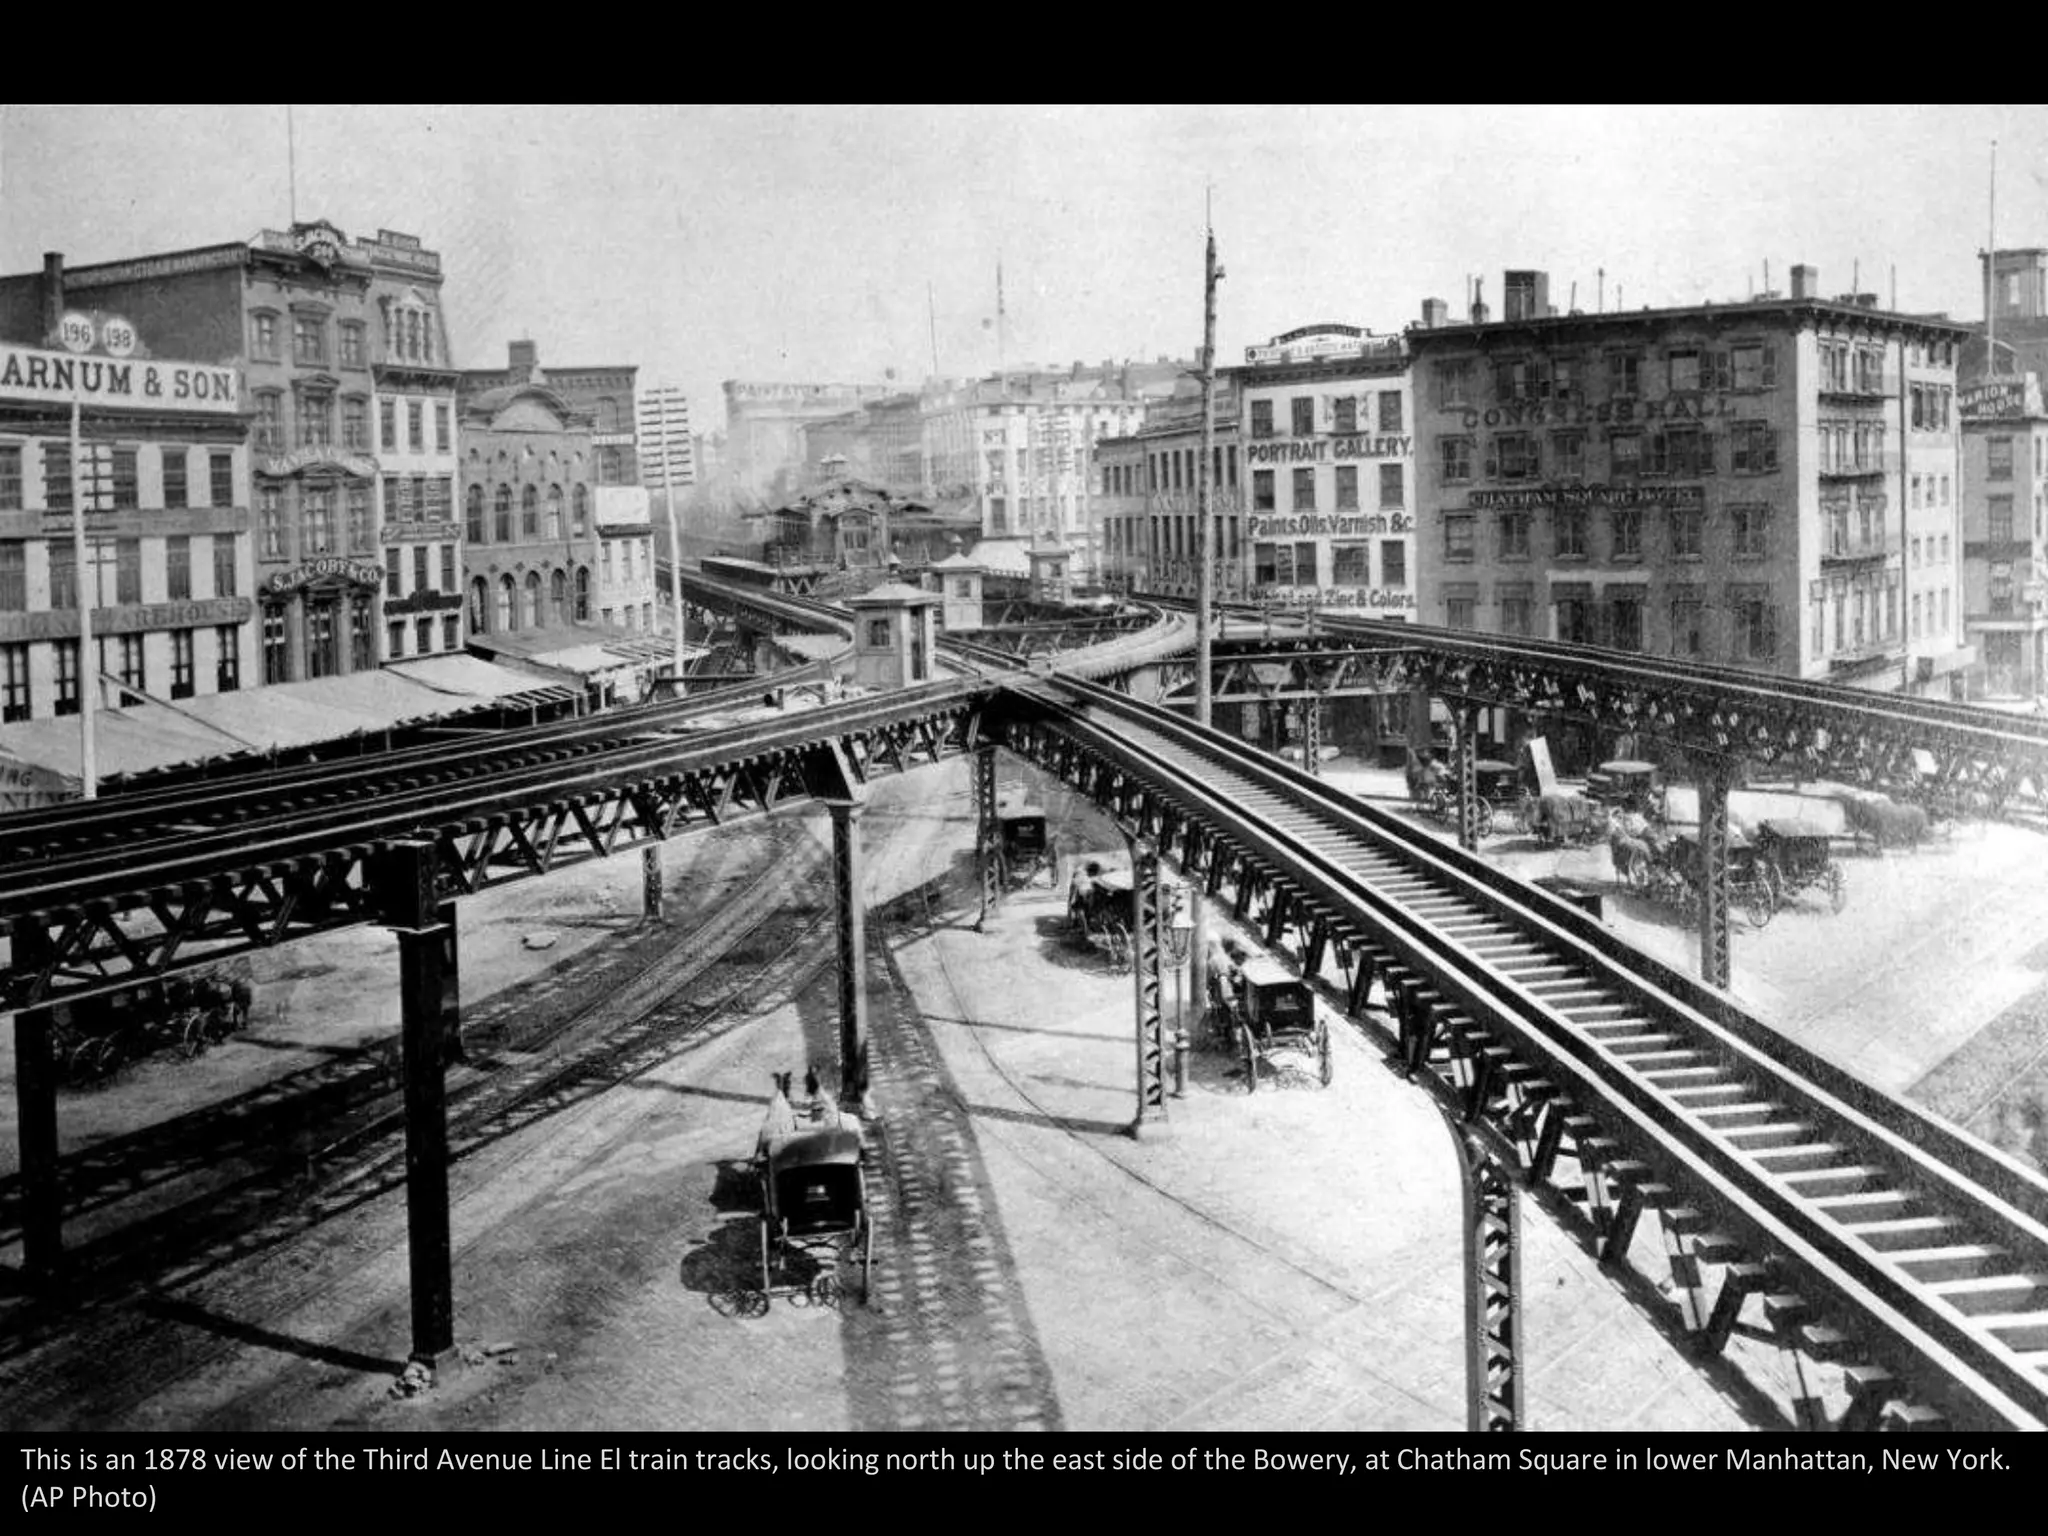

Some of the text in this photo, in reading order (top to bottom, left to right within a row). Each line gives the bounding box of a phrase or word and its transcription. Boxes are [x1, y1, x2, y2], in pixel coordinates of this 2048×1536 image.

[63, 322, 91, 344] 196
[105, 327, 132, 349] 198
[0, 353, 132, 395] ARNUM
[144, 367, 162, 396] &
[1248, 441, 1327, 466] PORTRAIT
